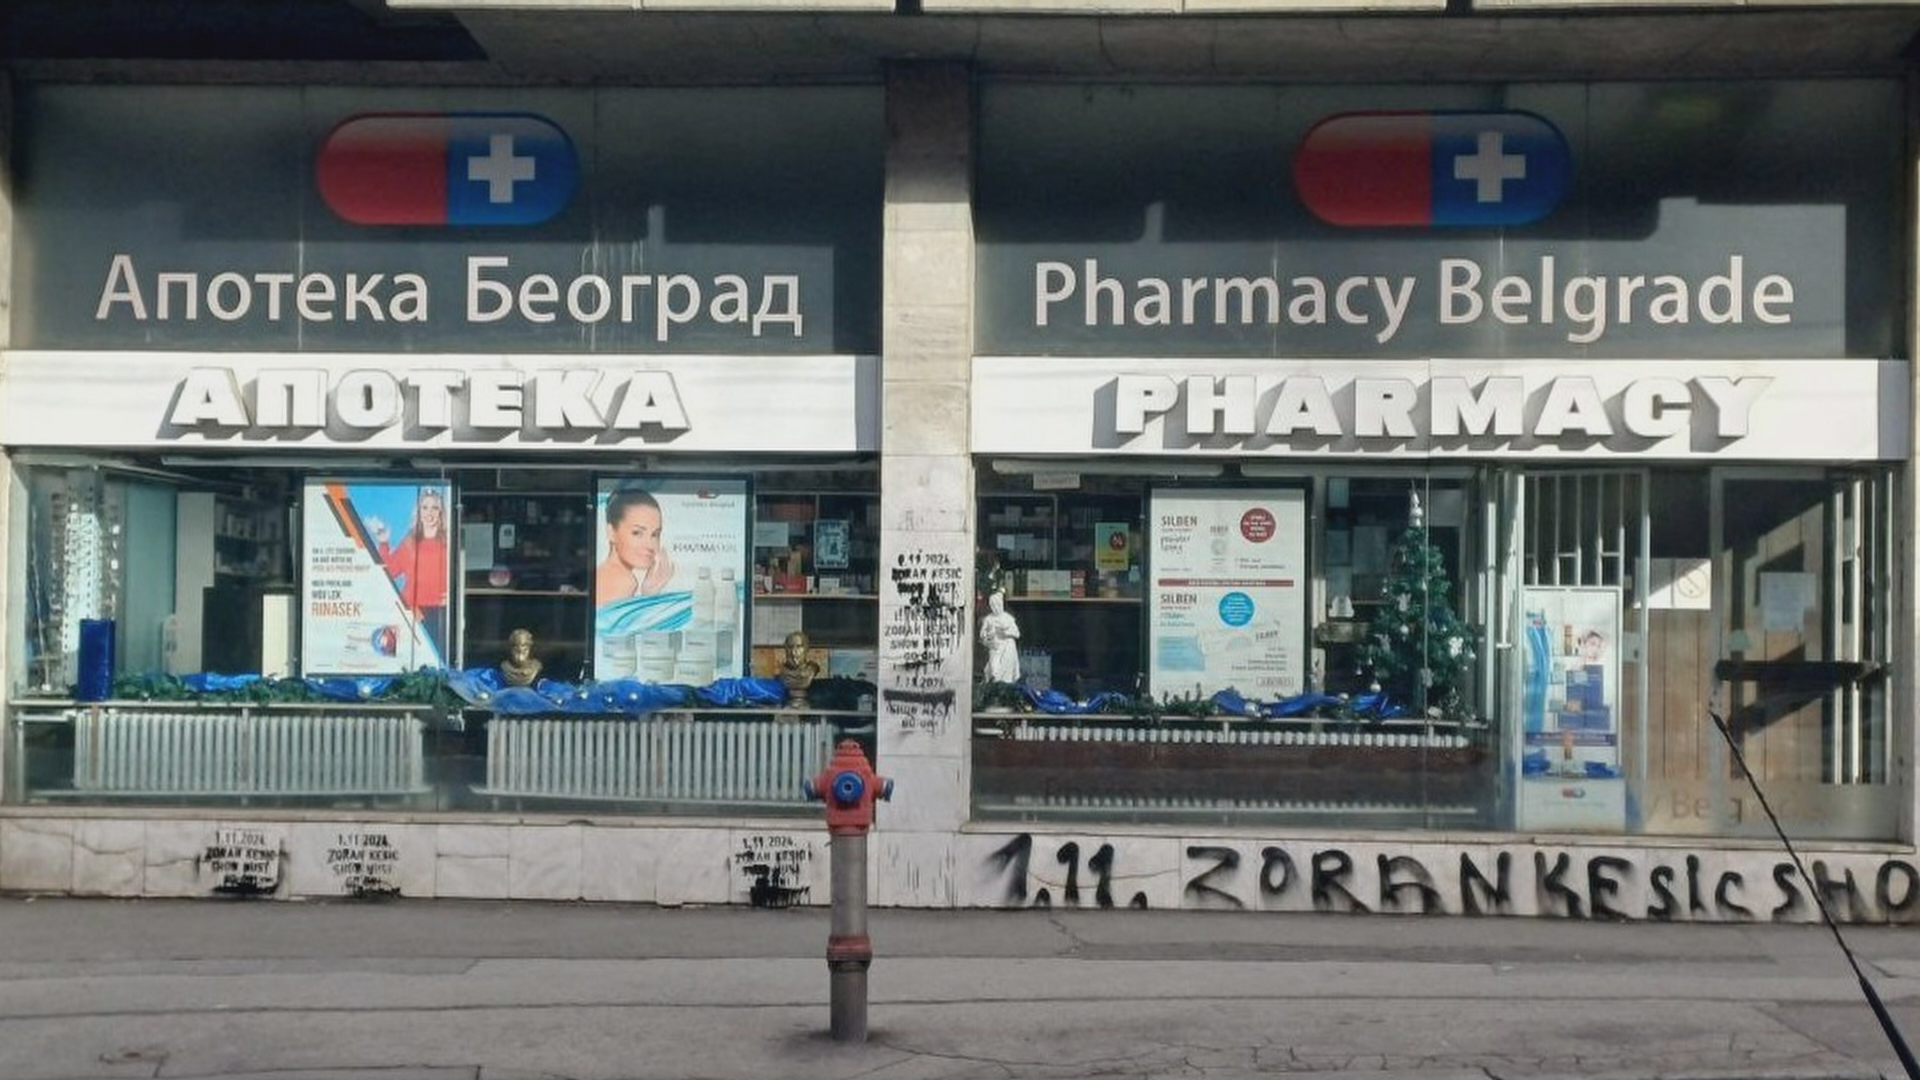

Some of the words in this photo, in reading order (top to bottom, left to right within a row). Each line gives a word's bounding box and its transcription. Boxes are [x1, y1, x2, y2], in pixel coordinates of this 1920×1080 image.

[95, 254, 429, 323] Апотека
[466, 256, 804, 341] Београд
[1035, 258, 1416, 343] Pharmacy
[1439, 255, 1795, 342] Belgrade
[163, 367, 692, 440] АПОТЕКА
[1106, 374, 1775, 446] PHARMACY
[1161, 515, 1198, 527] SILBEN
[1160, 593, 1198, 604] SILBEN
[1183, 846, 1512, 916] ZORAN
